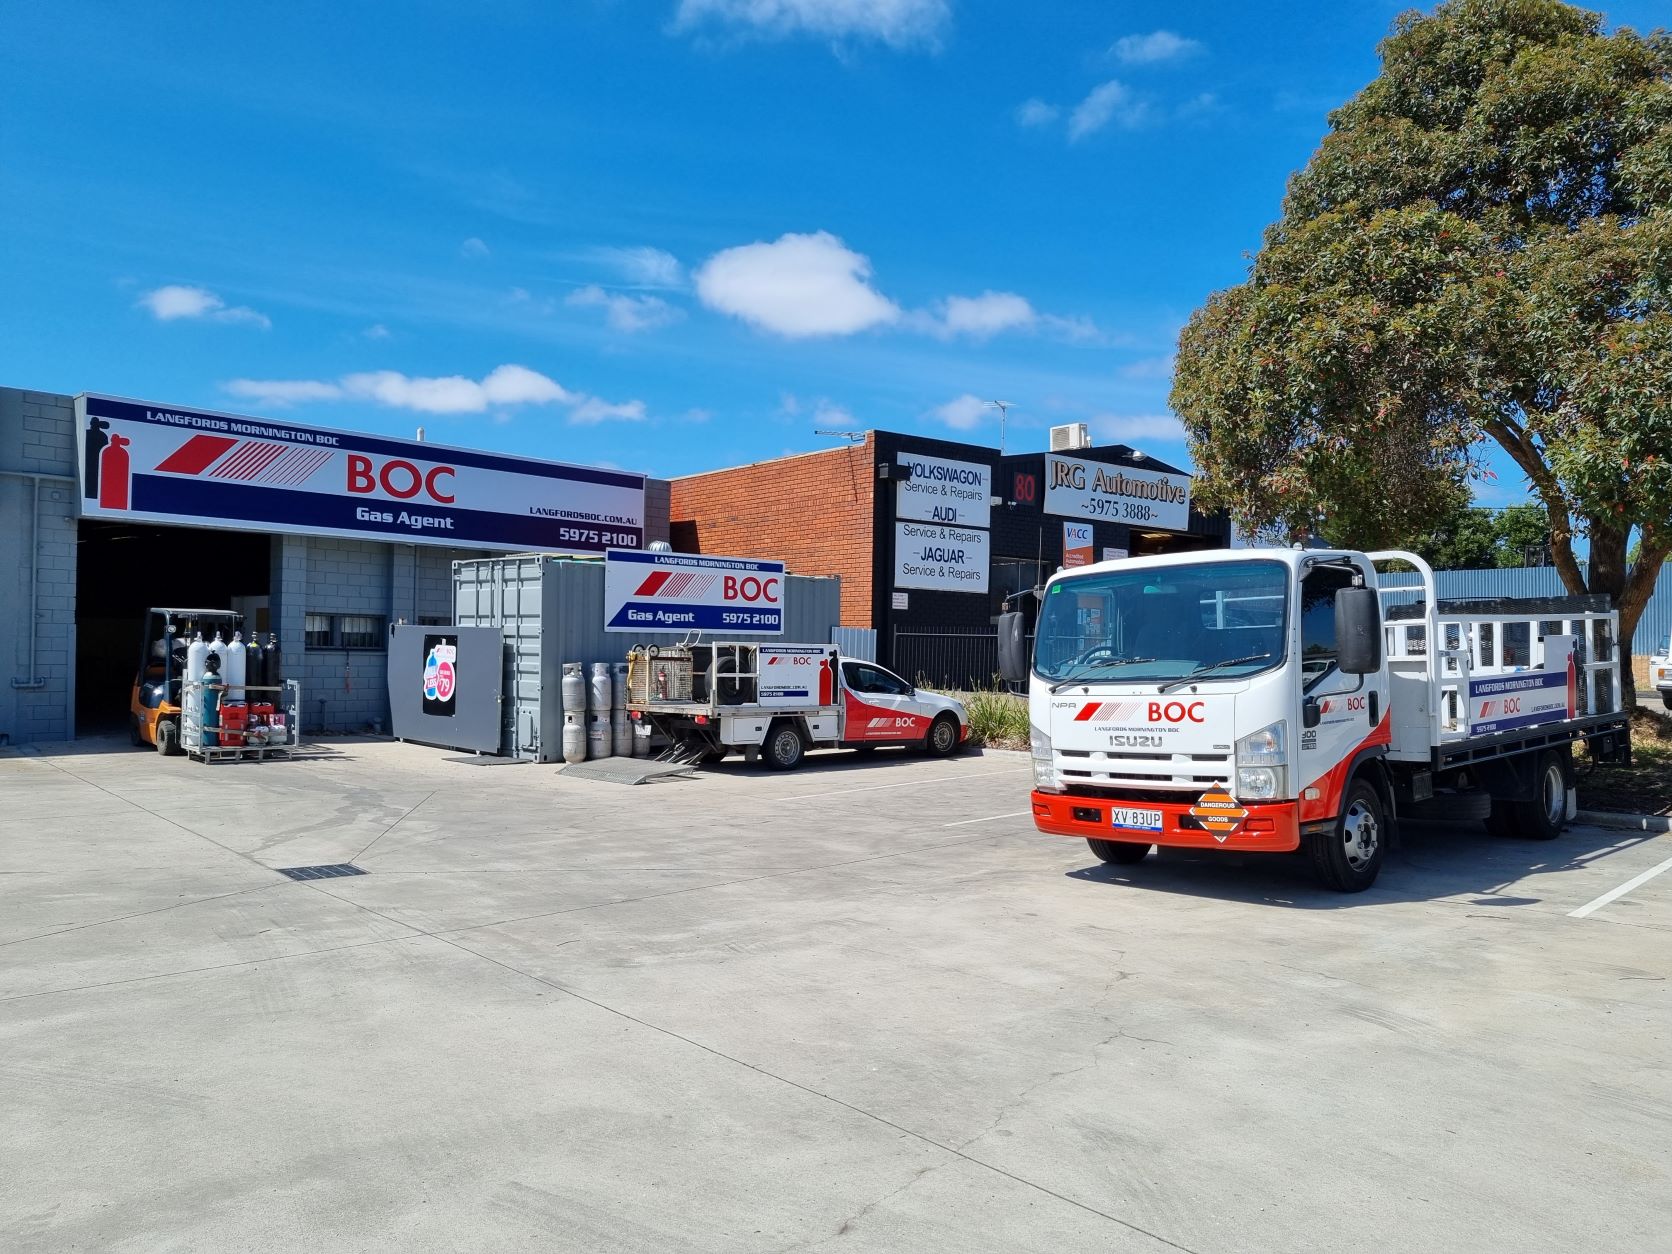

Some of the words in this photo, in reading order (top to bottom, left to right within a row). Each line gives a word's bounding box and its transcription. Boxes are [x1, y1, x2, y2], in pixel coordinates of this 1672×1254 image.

[147, 411, 228, 431] LANGFORDS
[230, 422, 313, 442] MORNINGTON
[316, 435, 339, 446] BOC
[347, 454, 455, 504] BOC
[907, 462, 982, 487] VOLKSWAGON
[1050, 460, 1085, 490] JRG
[1092, 468, 1186, 504] Automotive
[905, 481, 938, 495] Service
[940, 485, 947, 496] &
[951, 487, 983, 501] Repairs
[1015, 474, 1035, 501] 80
[356, 507, 394, 523] Gas
[397, 512, 455, 529] Agent
[529, 507, 637, 525] LANGFORDSBOC.COM.AU
[932, 506, 957, 522] AUDI
[560, 528, 598, 543] 5975
[602, 532, 636, 546] 2100
[904, 524, 937, 537] Service
[939, 528, 946, 540] &
[949, 529, 982, 544] Repairs
[1067, 528, 1088, 539] VACC
[655, 556, 698, 566] LANGFORDS
[699, 560, 745, 570] MORNINGTON
[746, 563, 759, 571] BOC
[921, 547, 965, 564] JAGUAR
[903, 563, 936, 577] Service
[938, 567, 945, 578] &
[948, 567, 981, 581] Repairs
[723, 576, 778, 602] BOC
[628, 610, 653, 621] Gas
[655, 610, 695, 624] Agent
[722, 613, 750, 624] 5975
[752, 614, 779, 625] 2100
[793, 657, 811, 665] BOC
[1475, 682, 1505, 694] LANGFORDS
[1505, 679, 1535, 690] MORNINGTON
[1535, 678, 1543, 687] BOC
[1148, 702, 1204, 722] BOC
[1347, 697, 1365, 711] BOC
[1503, 697, 1520, 714] BOC
[896, 717, 915, 727] BOC
[1109, 735, 1163, 747] ISUZU
